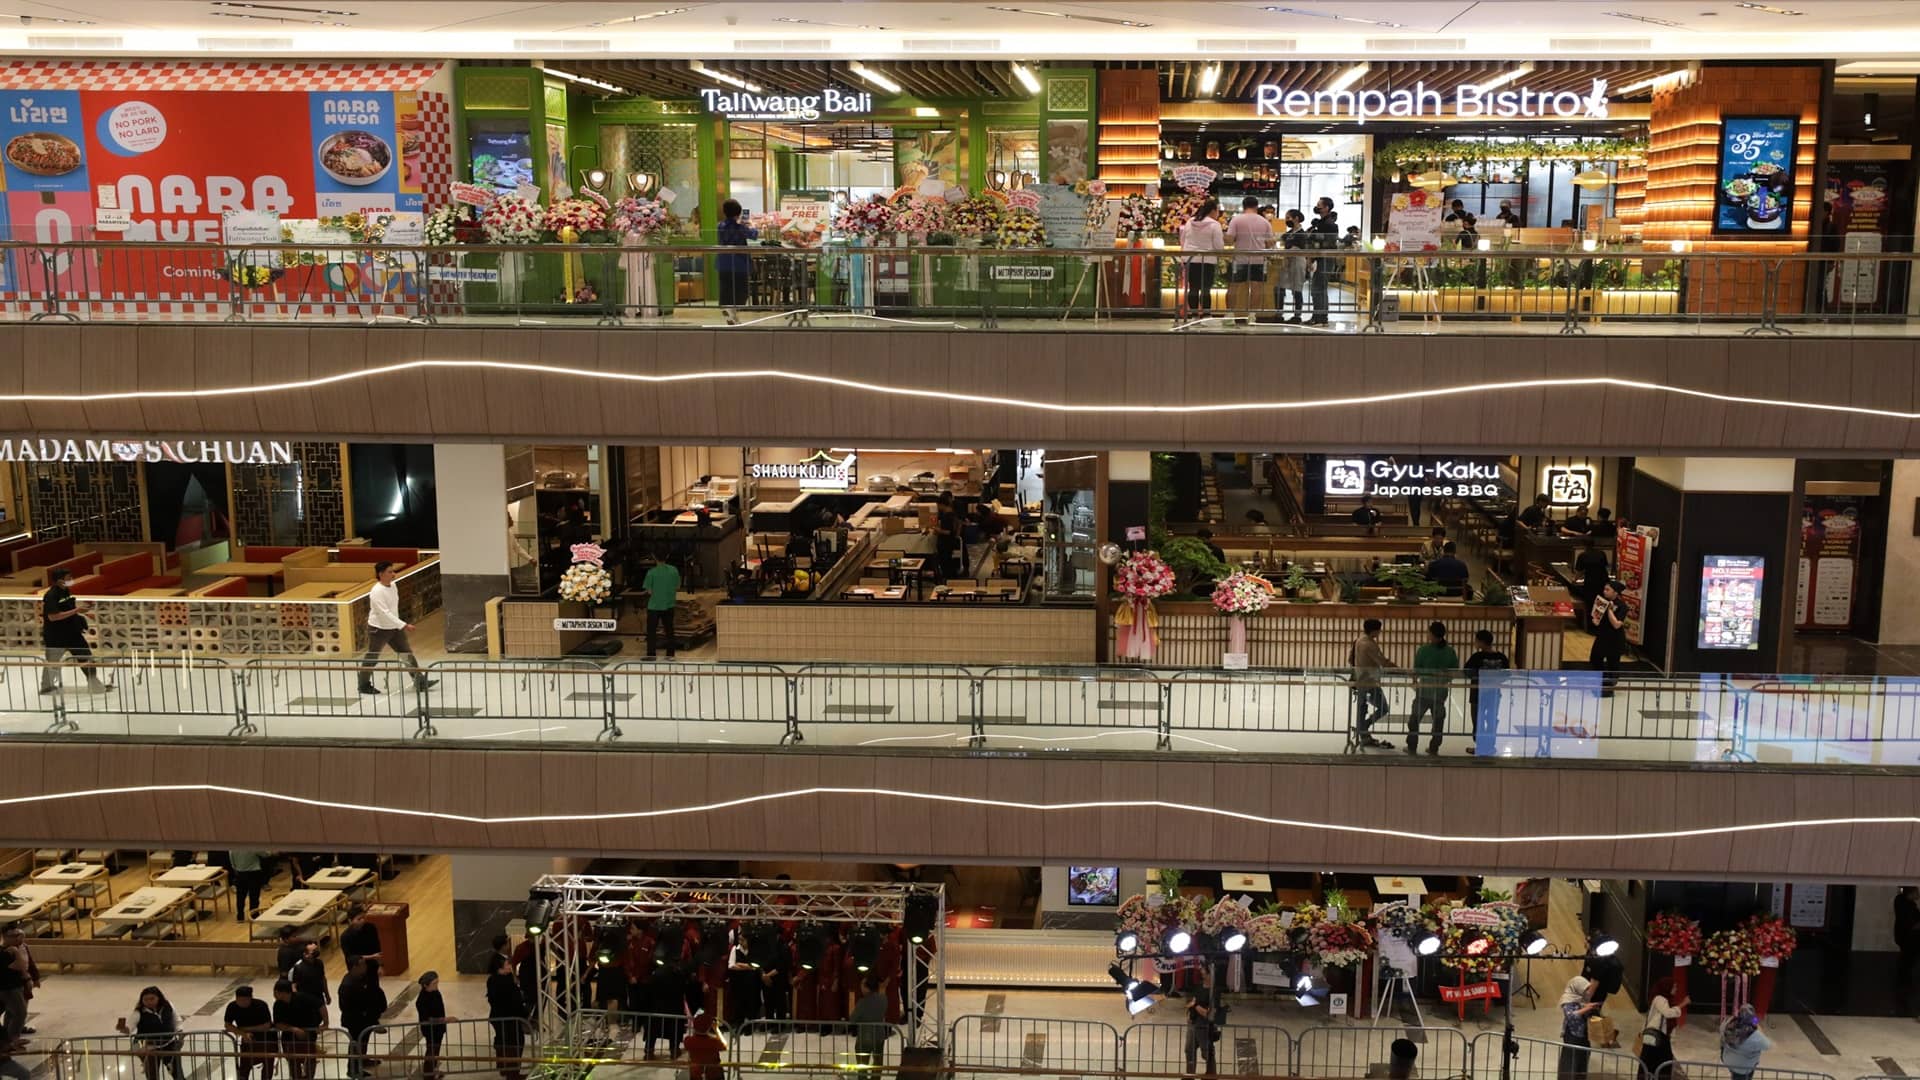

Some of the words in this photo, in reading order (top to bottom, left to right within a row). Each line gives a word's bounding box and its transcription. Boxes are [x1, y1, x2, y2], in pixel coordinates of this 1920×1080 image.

[323, 100, 380, 113] NARA
[701, 89, 821, 121] Taliwang
[823, 89, 872, 113] Bali
[1256, 82, 1442, 125] Rempah
[1457, 85, 1581, 117] Bistro
[115, 120, 130, 129] NO
[131, 116, 158, 127] PORK
[324, 114, 380, 125] MYEON
[118, 130, 134, 139] NO
[135, 126, 160, 137] LARD
[117, 174, 295, 214] NARA
[791, 210, 819, 218] FREE
[163, 265, 222, 280] Coming
[0, 439, 112, 462] MADAM
[1371, 460, 1500, 482] Gyu-Kaku
[1371, 483, 1453, 497] Japanese
[1456, 484, 1499, 497] BBQ
